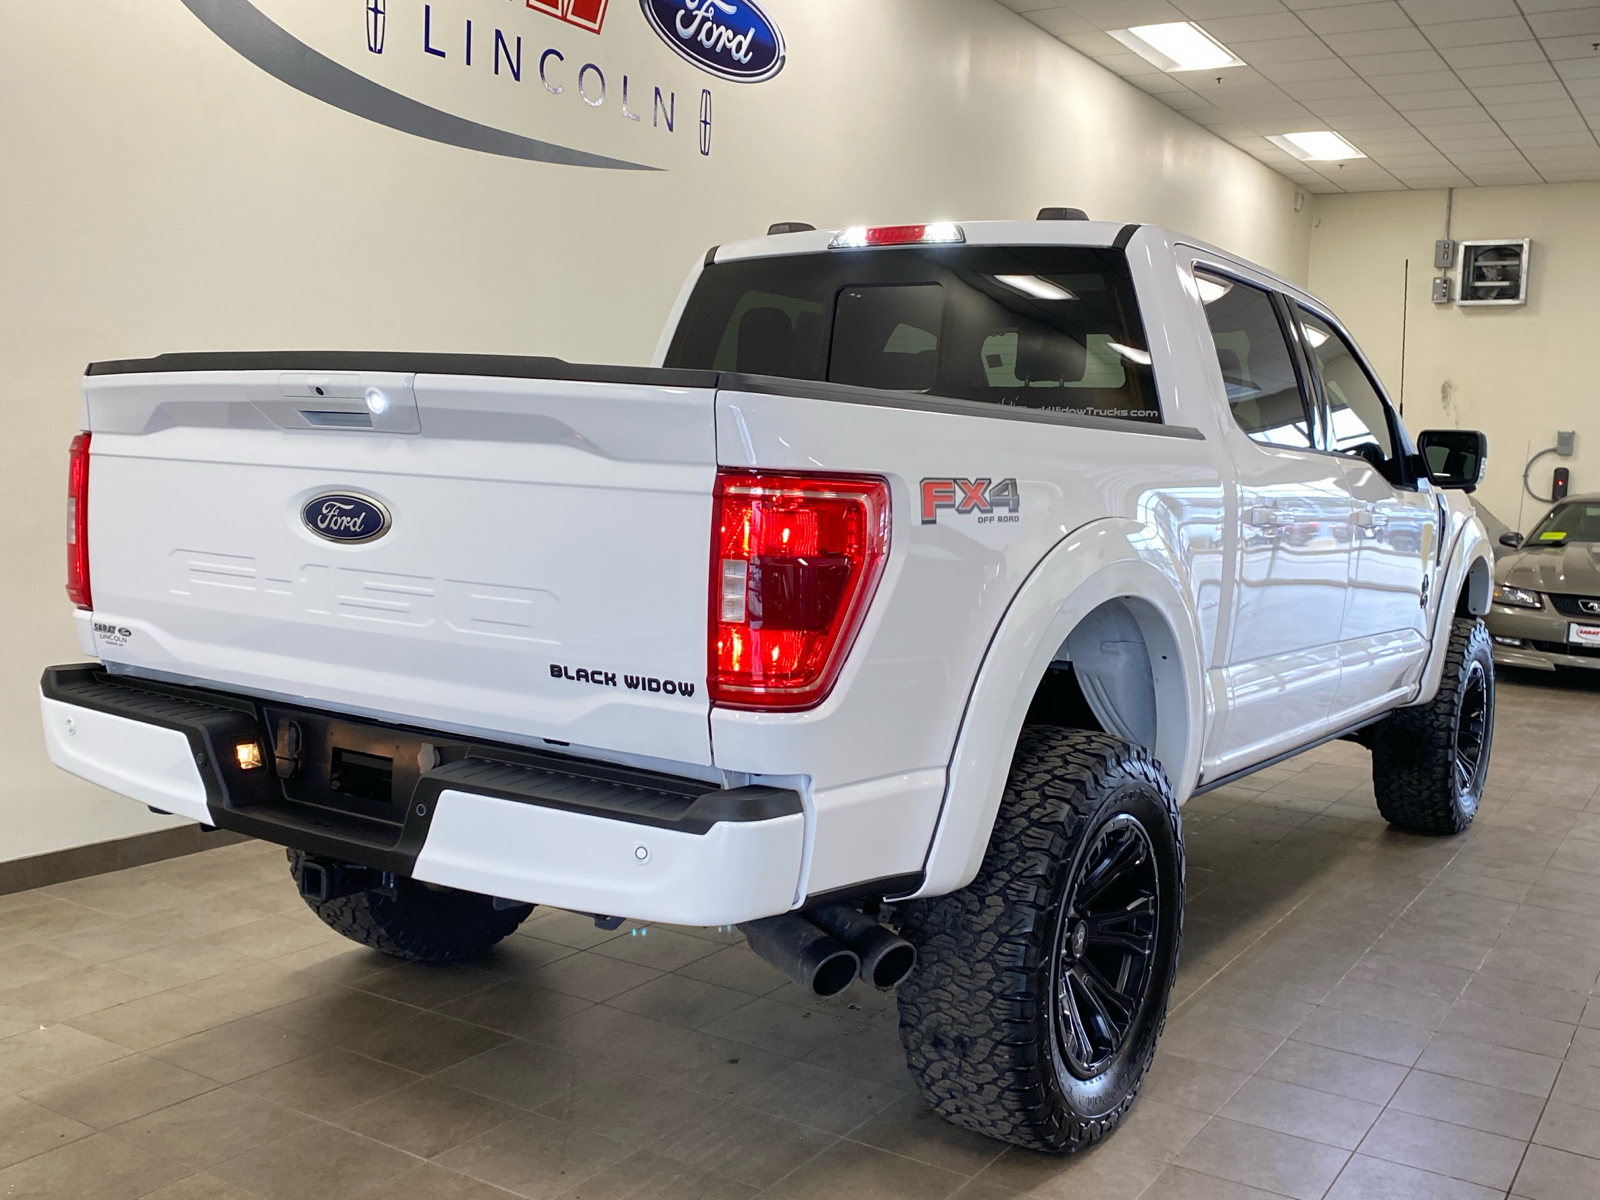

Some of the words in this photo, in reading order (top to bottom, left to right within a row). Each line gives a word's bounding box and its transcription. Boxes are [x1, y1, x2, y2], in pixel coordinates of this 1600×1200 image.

[675, 0, 756, 64] Ford
[423, 4, 675, 133] LINCOLN
[317, 501, 366, 532] Ford
[919, 477, 1020, 525] FX4
[977, 516, 995, 524] OFF
[997, 515, 1020, 523] ROAD
[100, 633, 127, 643] LINCOLN
[549, 663, 617, 687] BLACK
[623, 674, 695, 698] WIDOW
